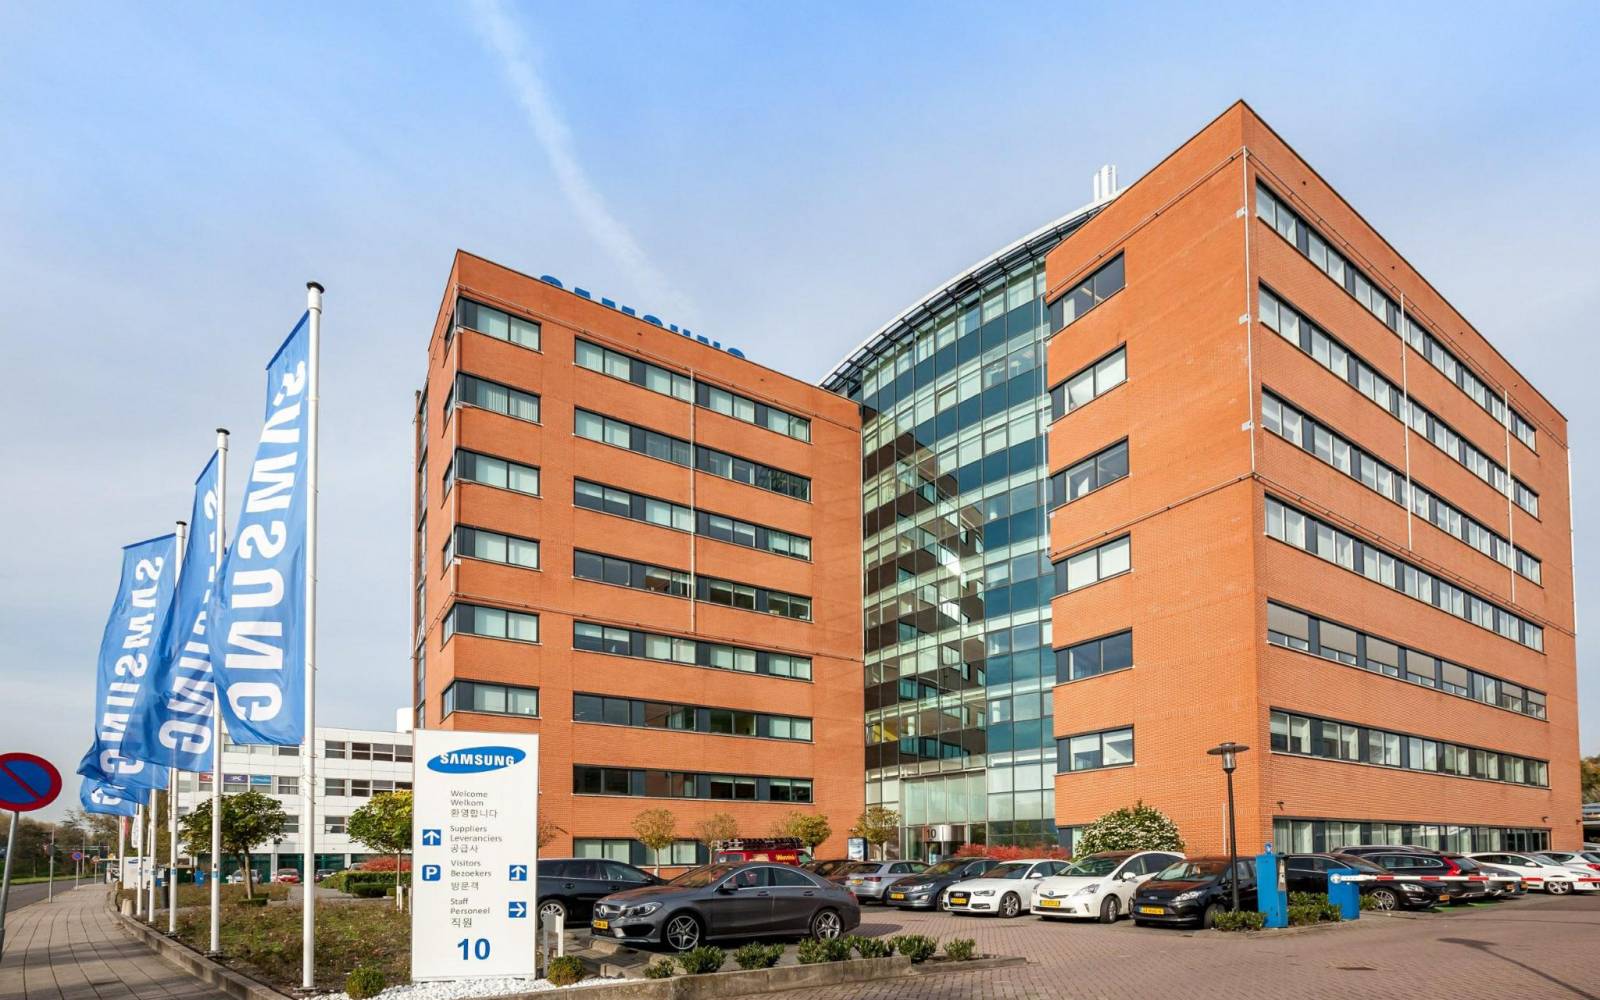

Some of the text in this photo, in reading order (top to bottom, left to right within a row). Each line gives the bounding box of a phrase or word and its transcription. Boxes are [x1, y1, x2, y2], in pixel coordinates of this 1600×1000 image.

[439, 752, 516, 768] SAMSUNG
[450, 790, 488, 798] Welcome
[450, 799, 484, 807] Welkom
[450, 825, 488, 834] Suppliers
[926, 828, 937, 839] 10
[450, 870, 492, 878] Bezoekers
[450, 907, 490, 915] Personeel
[457, 938, 491, 961] 10
